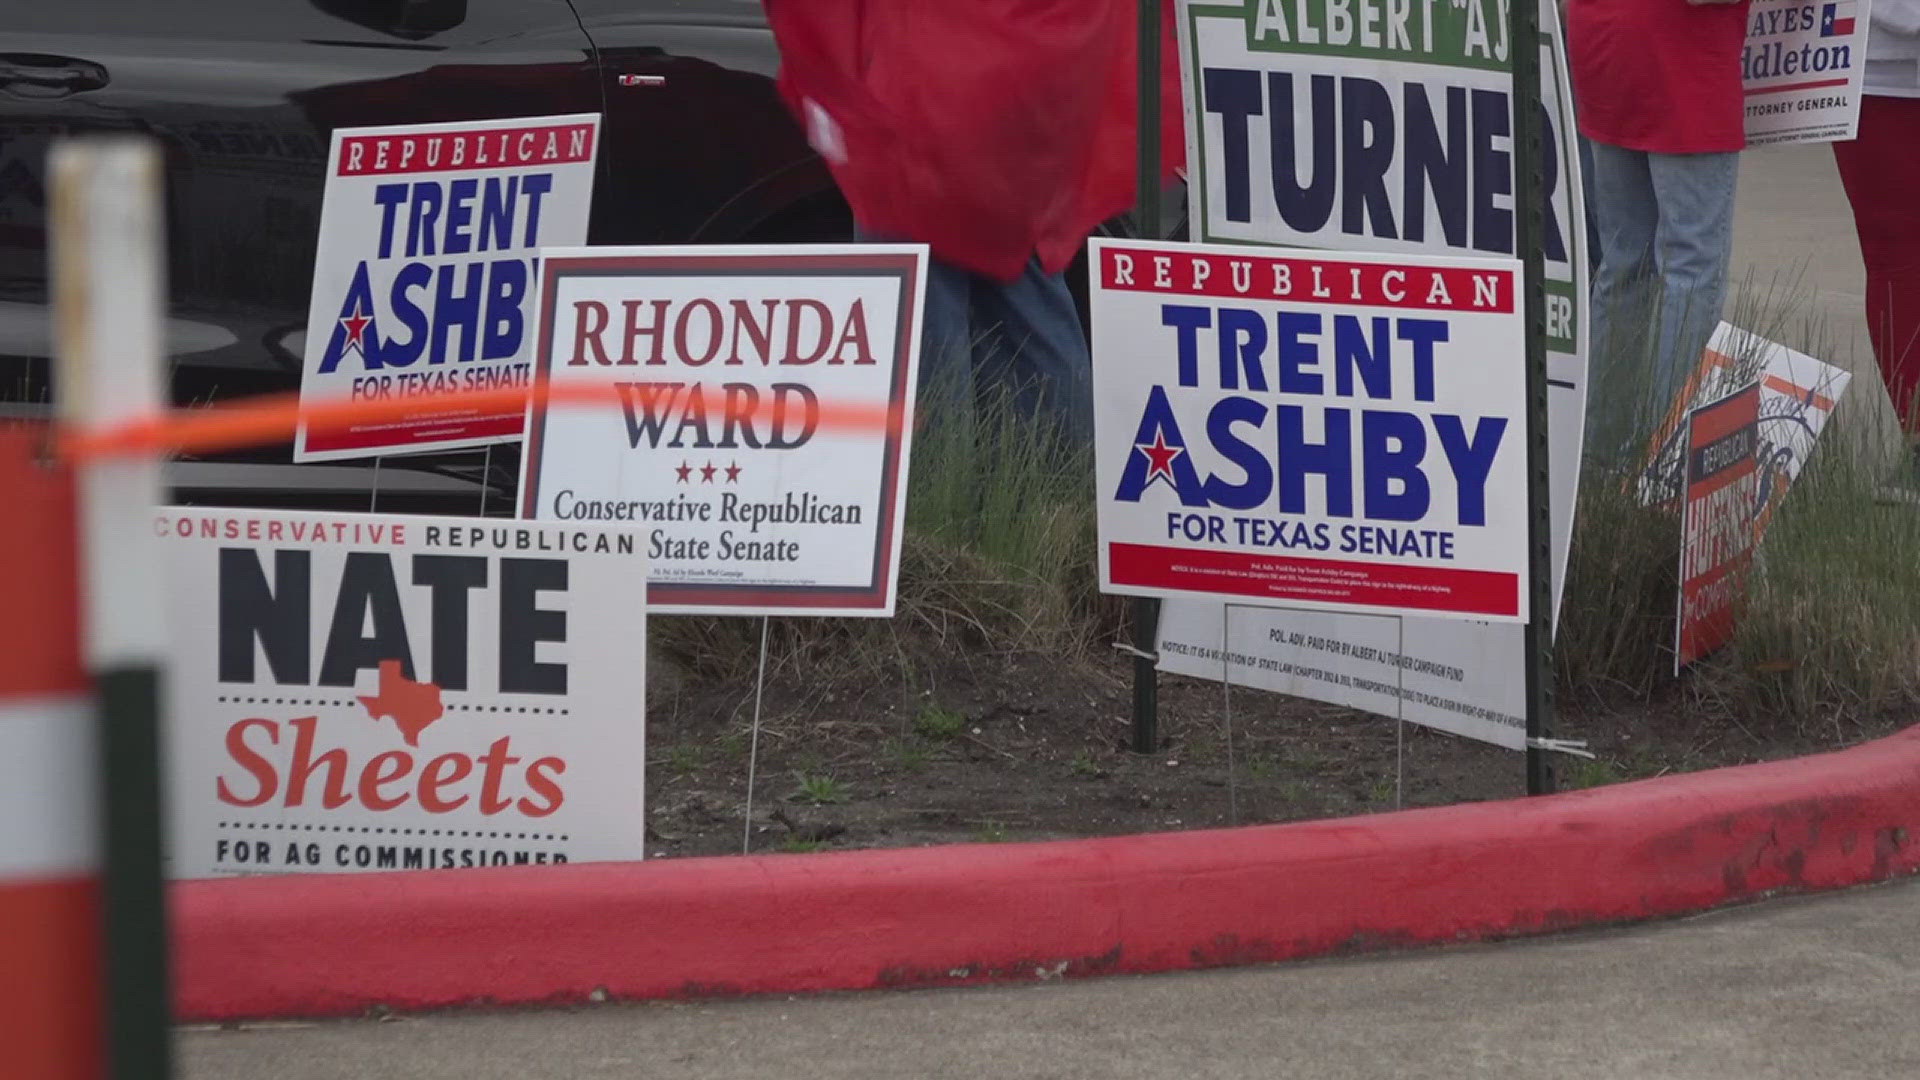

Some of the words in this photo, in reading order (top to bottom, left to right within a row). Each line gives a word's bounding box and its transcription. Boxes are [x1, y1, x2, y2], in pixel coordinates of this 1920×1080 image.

[1254, 0, 1437, 53] ALBERT
[1746, 5, 1814, 37] AYES
[1746, 101, 1794, 117] TTORNEY
[1797, 96, 1848, 111] GENERAL
[346, 129, 587, 171] REPUBLICAN
[1204, 67, 1568, 263] TURNER
[374, 173, 553, 259] TRENT
[1114, 253, 1499, 307] REPUBLICAN
[567, 297, 877, 367] RHONDA
[1162, 304, 1449, 402] TRENT
[352, 375, 392, 402] FOR
[397, 369, 458, 397] TEXAS
[614, 381, 820, 449] WARD
[1114, 384, 1509, 527] ASHBY
[554, 490, 711, 522] Conservative
[720, 492, 862, 533] Republican
[153, 517, 407, 545] CONSERVATIVE
[425, 526, 635, 554] REPUBLICAN
[648, 530, 709, 560] State
[717, 530, 799, 562] Senate
[1168, 513, 1227, 544] FOR
[1233, 516, 1331, 551] TEXAS
[1340, 525, 1455, 560] SENATE
[218, 547, 569, 695] NATE
[1259, 658, 1279, 671] STATE
[1308, 636, 1324, 650] PAID
[1326, 639, 1340, 653] FOR
[1341, 642, 1351, 656] BY
[1352, 645, 1377, 661] ALBERT
[1378, 650, 1387, 664] AJ
[1446, 666, 1464, 682] FUND
[216, 716, 566, 817] Sheets
[216, 840, 270, 864] FOR
[285, 842, 321, 866] AG
[336, 845, 569, 870] COMMISSIONER
